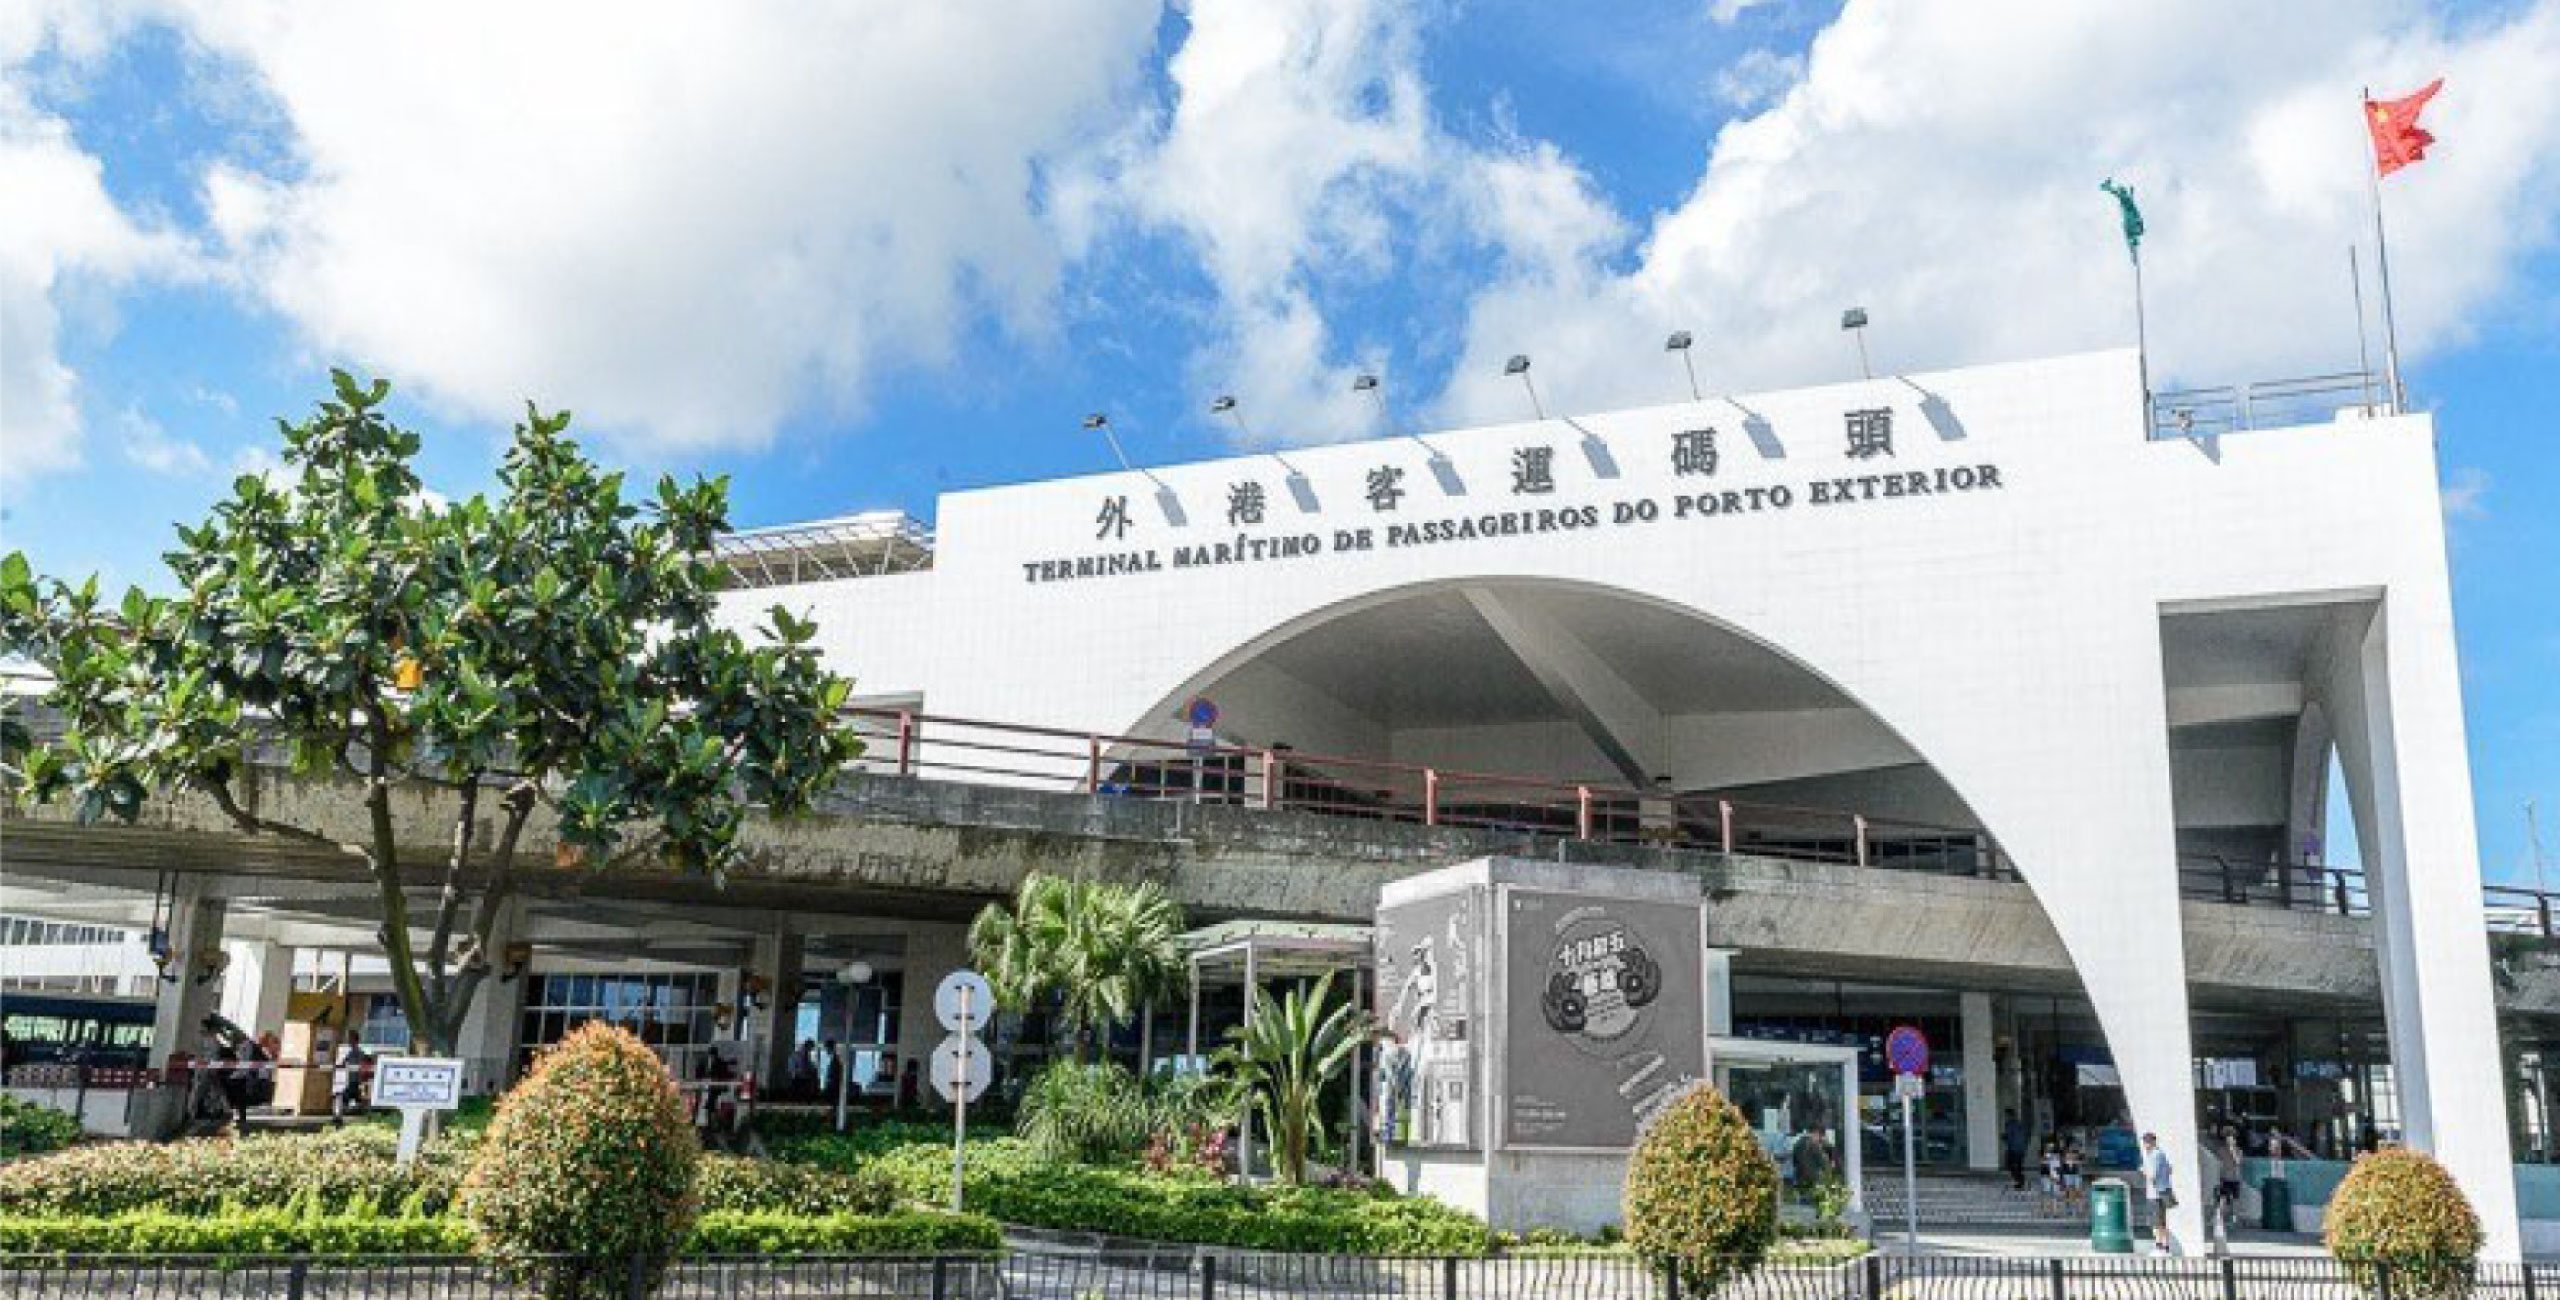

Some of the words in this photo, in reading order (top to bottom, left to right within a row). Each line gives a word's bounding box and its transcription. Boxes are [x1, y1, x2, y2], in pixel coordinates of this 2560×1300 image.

[1023, 550, 1162, 583] TERMINAL
[1172, 533, 1322, 568] MARÍTIMO
[1333, 528, 1374, 552] DE
[1386, 504, 1599, 548] PASSAGEIROS
[1612, 498, 1659, 524] DO
[1673, 484, 1793, 518] PORTO
[1808, 464, 2003, 505] EXTERIOR
[1096, 406, 1894, 541] 外港客運碼頭
